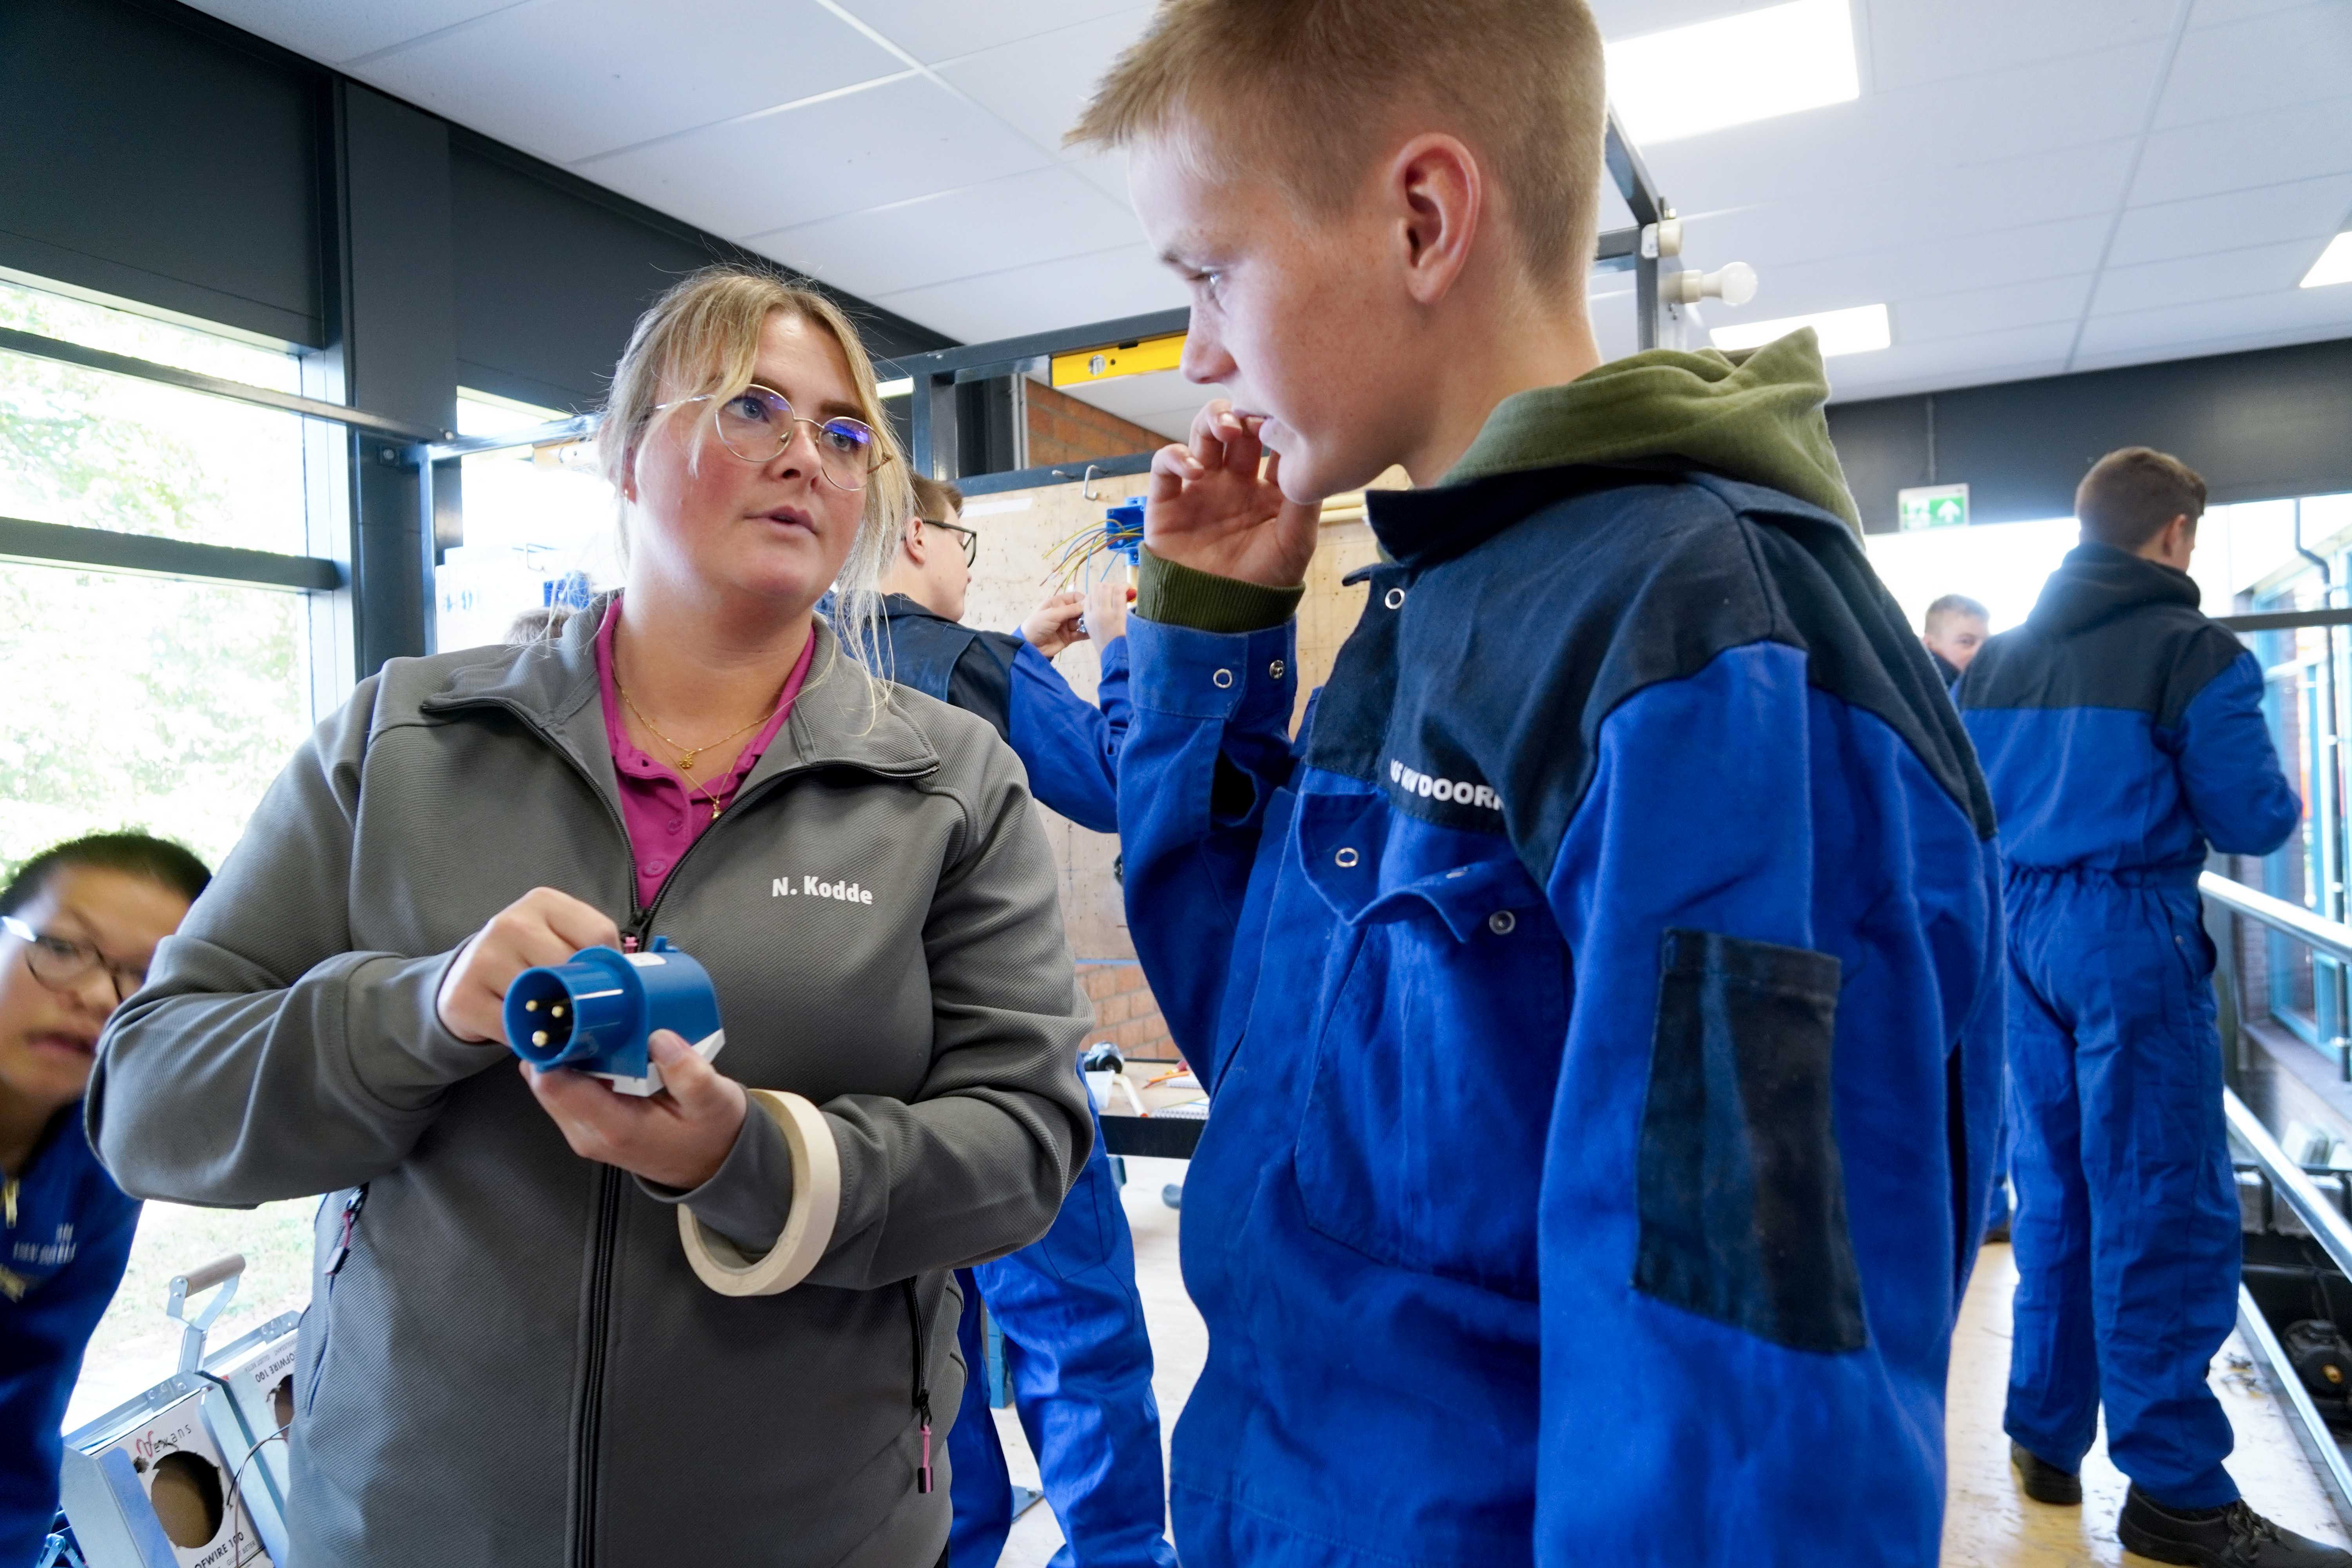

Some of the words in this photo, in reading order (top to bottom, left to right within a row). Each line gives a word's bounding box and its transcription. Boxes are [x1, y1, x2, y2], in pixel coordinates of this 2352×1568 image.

[772, 877, 797, 897] N.
[804, 875, 873, 904] Kodde
[269, 1352, 295, 1374] OFWIRE
[136, 1424, 192, 1458] Nexans
